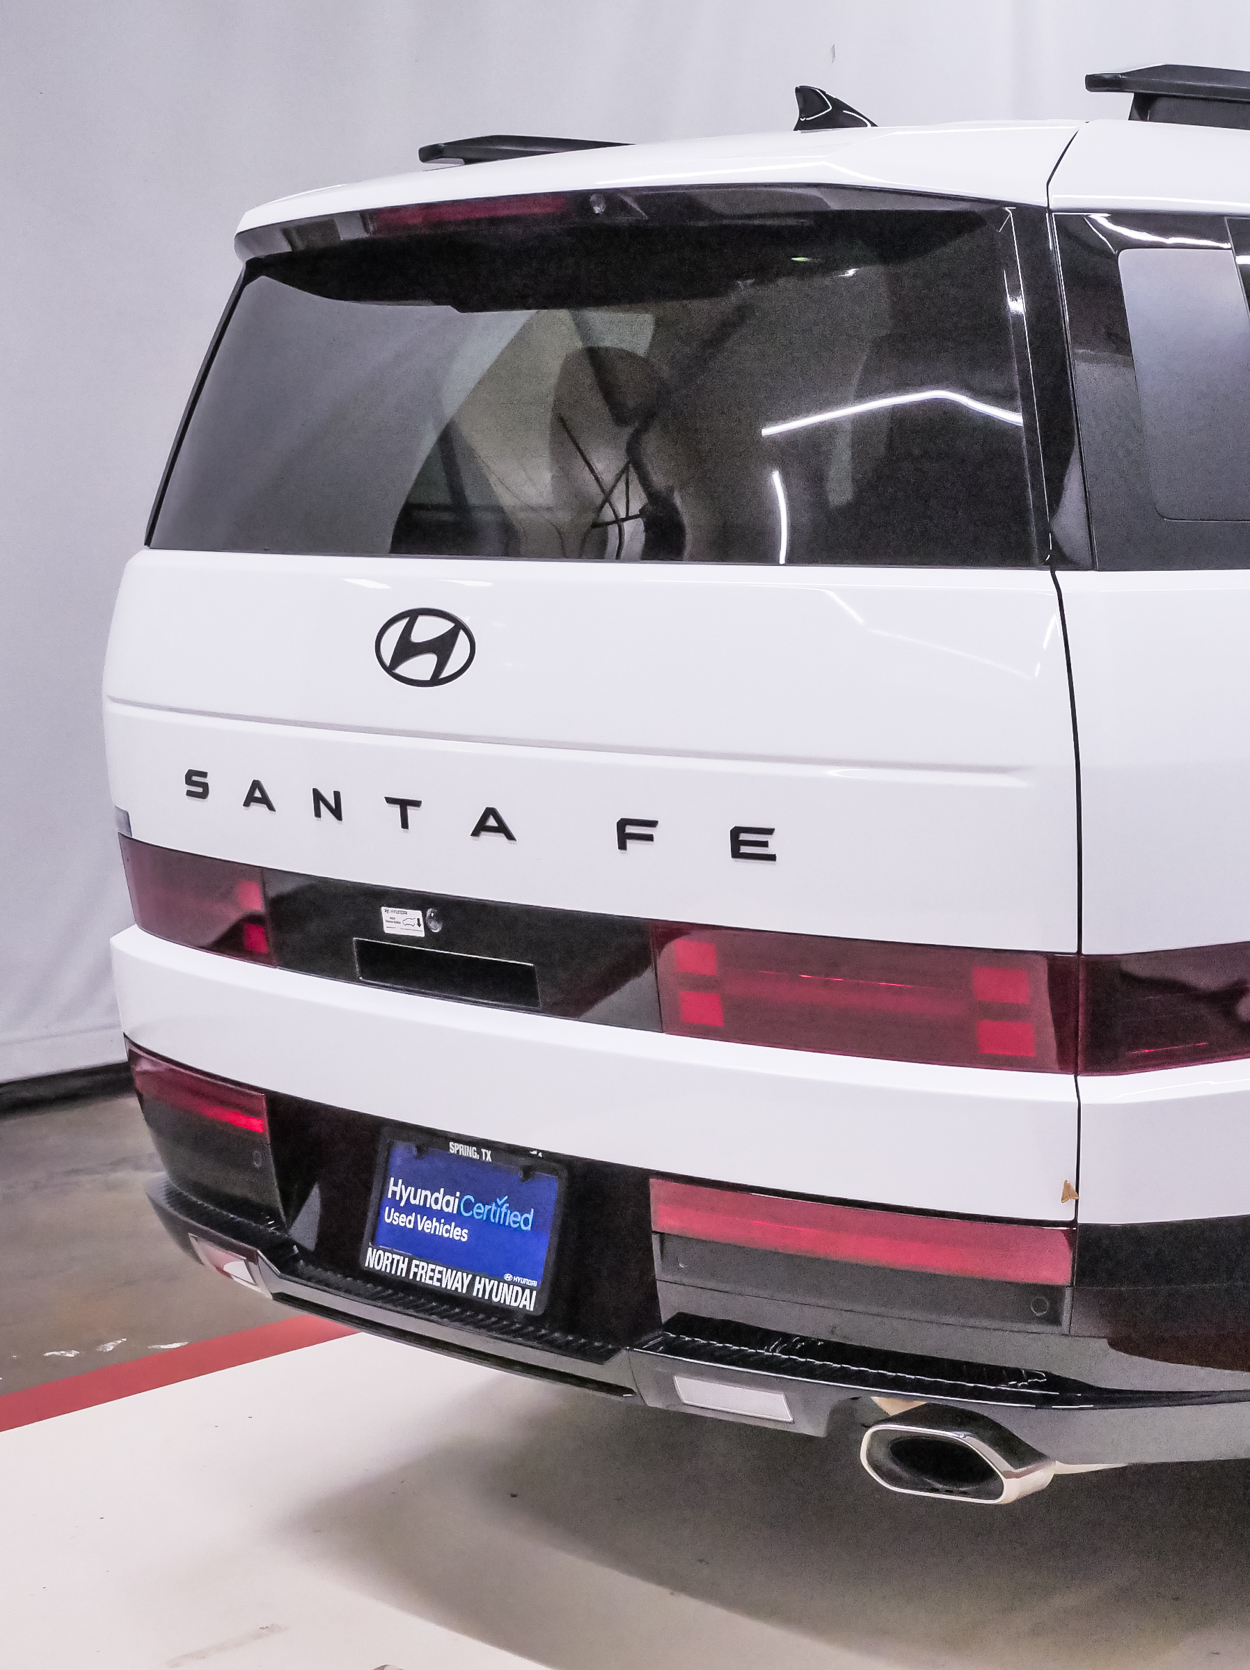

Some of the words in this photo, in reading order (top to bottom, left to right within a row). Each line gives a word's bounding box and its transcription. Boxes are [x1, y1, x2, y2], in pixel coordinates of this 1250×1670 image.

[184, 768, 517, 842] SANTA
[616, 817, 777, 862] FE
[449, 1141, 480, 1160] SPRING,
[481, 1148, 493, 1162] TX
[384, 1206, 416, 1229] Used
[417, 1213, 469, 1242] Vehicles
[387, 1177, 460, 1214] Hyundai
[460, 1195, 534, 1231] Certified
[365, 1247, 409, 1278] NORTH
[409, 1259, 473, 1294] FREEWAY
[472, 1276, 537, 1311] HYUNDAI
[513, 1276, 538, 1287] HYUNDAI
